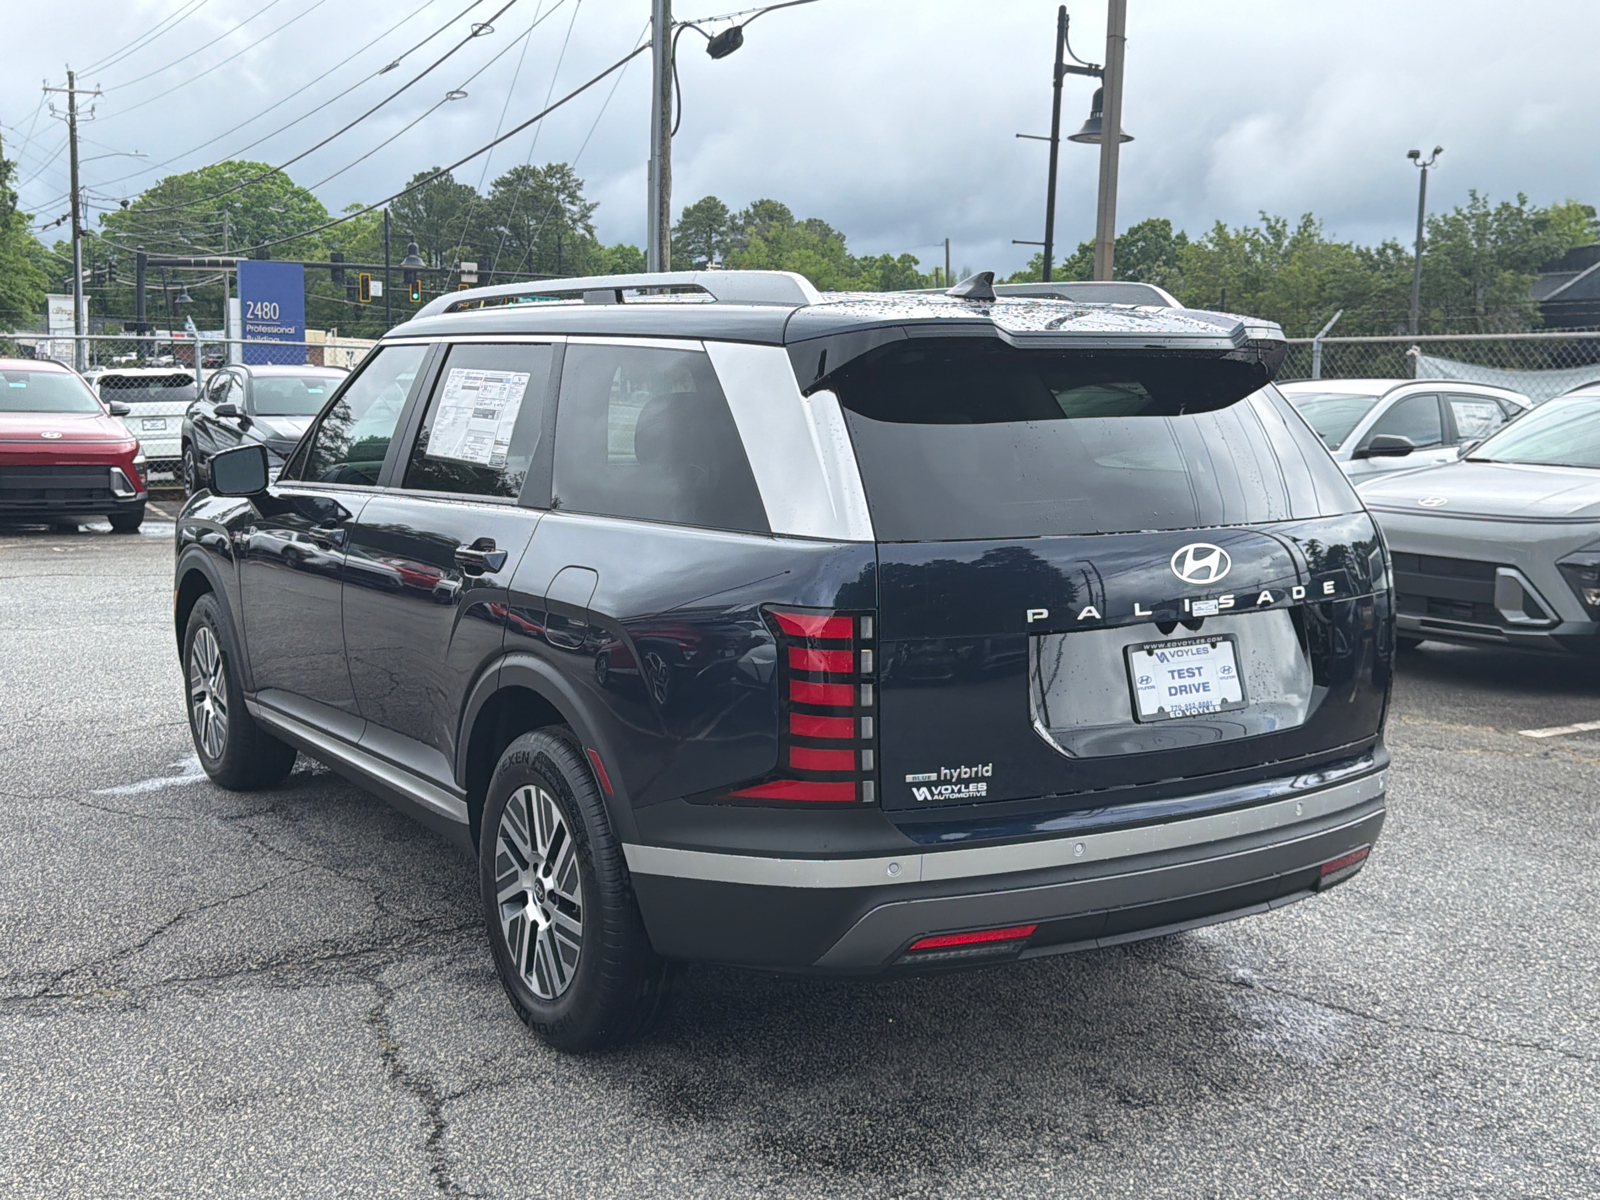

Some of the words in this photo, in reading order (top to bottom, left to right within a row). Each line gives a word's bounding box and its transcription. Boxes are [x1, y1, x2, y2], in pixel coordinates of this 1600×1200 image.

[246, 301, 280, 320] 2480
[246, 324, 296, 334] Professional
[1026, 580, 1336, 623] PALISADE
[1143, 636, 1223, 650] WWW.EDVOYLES.COM
[1168, 646, 1210, 659] VOYLES
[1167, 666, 1204, 681] TEST
[1167, 681, 1212, 697] DRIVE
[1184, 705, 1222, 716] VOYLES
[496, 750, 531, 779] NEXEN
[940, 762, 993, 783] hybrid
[931, 782, 987, 795] VOYLES
[932, 790, 987, 801] AUTOMOTIVE
